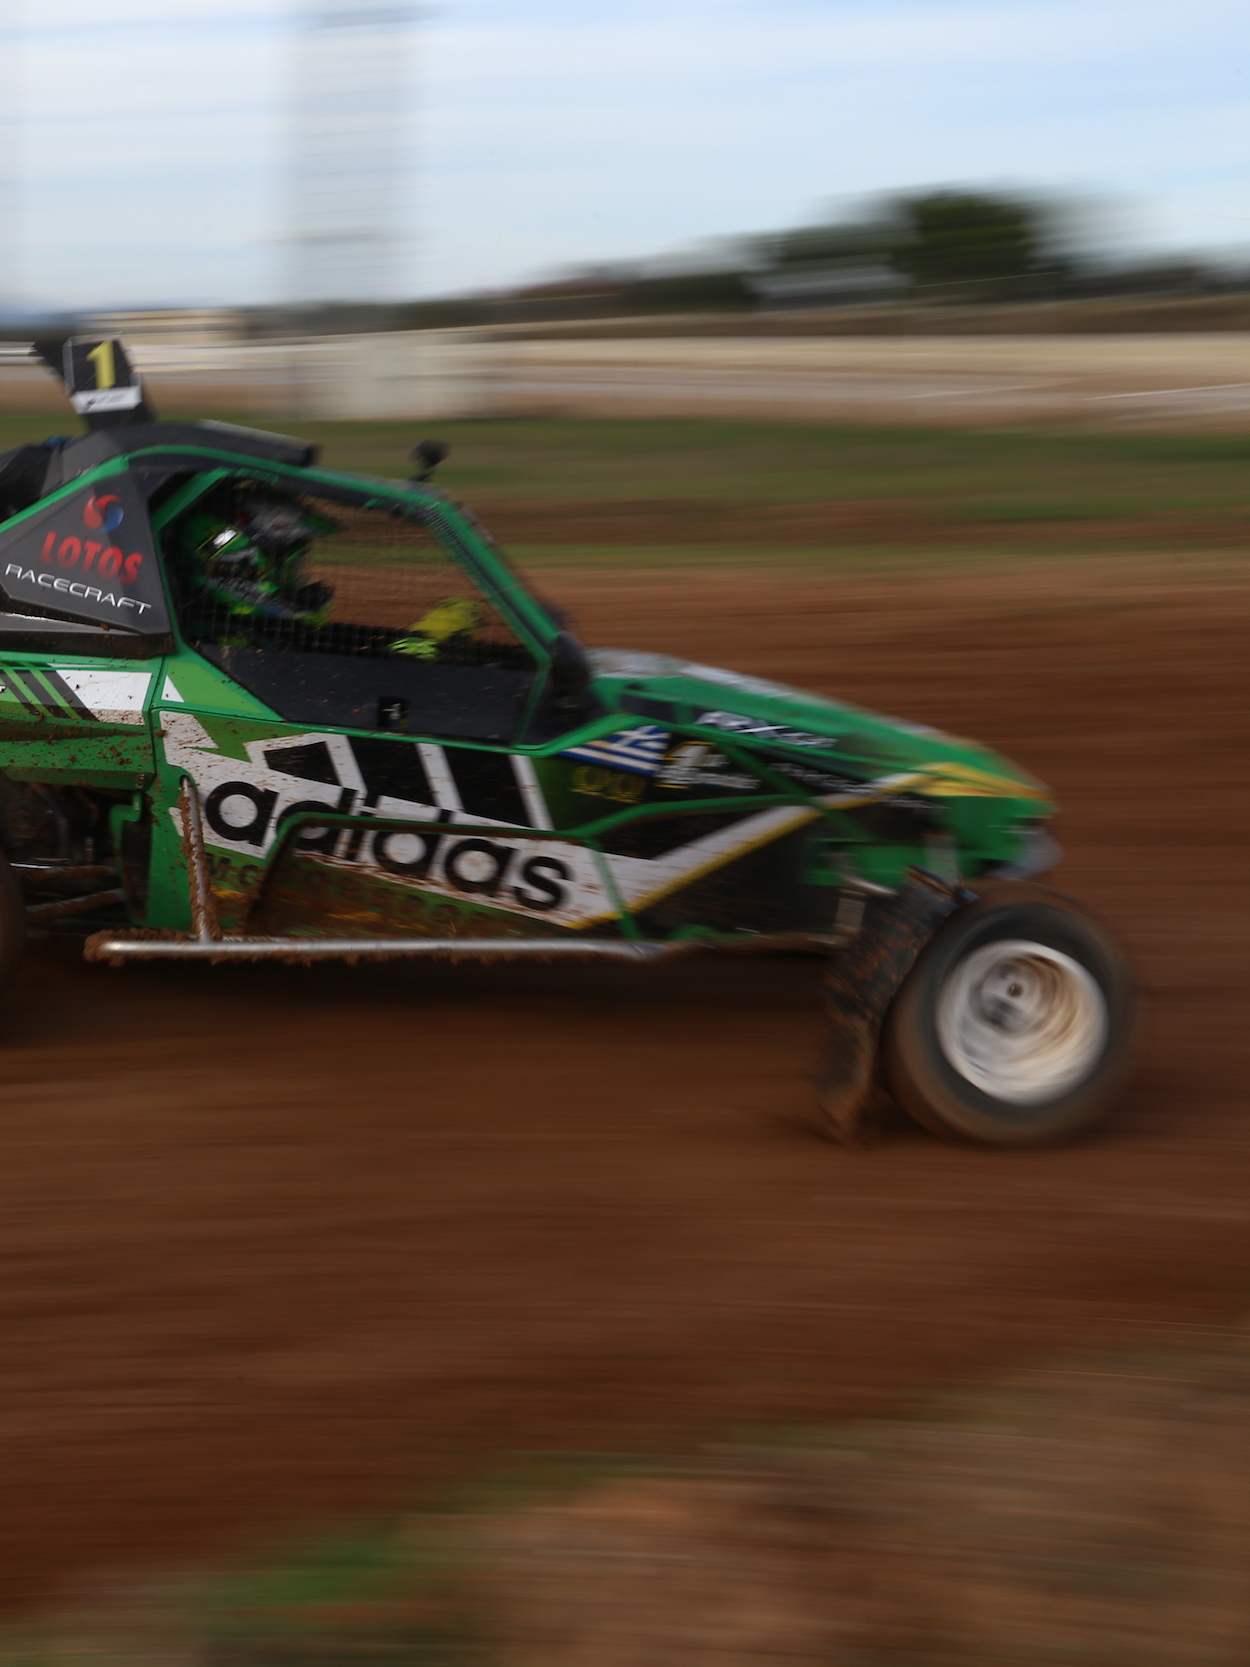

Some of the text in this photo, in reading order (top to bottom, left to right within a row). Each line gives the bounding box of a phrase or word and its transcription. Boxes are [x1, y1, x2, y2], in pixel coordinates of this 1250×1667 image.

[86, 340, 115, 390] 1
[40, 531, 143, 584] LOTOS
[4, 562, 153, 615] RACECRAFT
[204, 780, 575, 911] adidas
